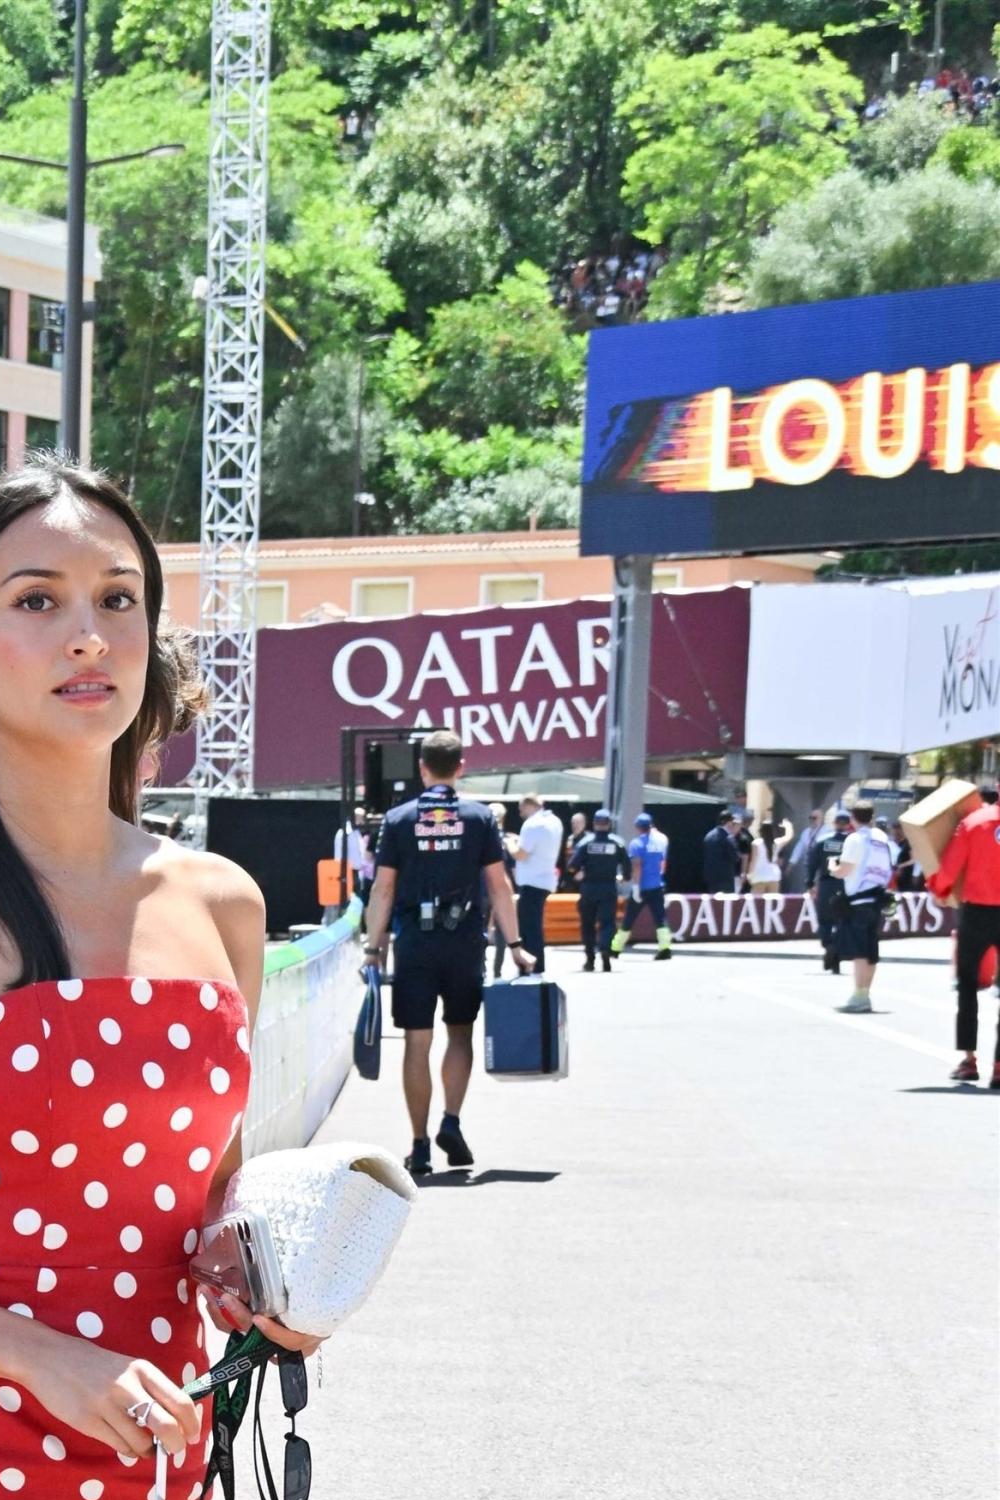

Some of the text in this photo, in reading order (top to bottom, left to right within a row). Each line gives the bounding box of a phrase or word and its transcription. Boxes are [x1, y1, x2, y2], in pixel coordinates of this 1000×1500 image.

[332, 617, 612, 719] QATAR
[938, 658, 1000, 719] MON
[412, 694, 608, 748] AIRWAY
[664, 890, 944, 941] QATAR AAYS
